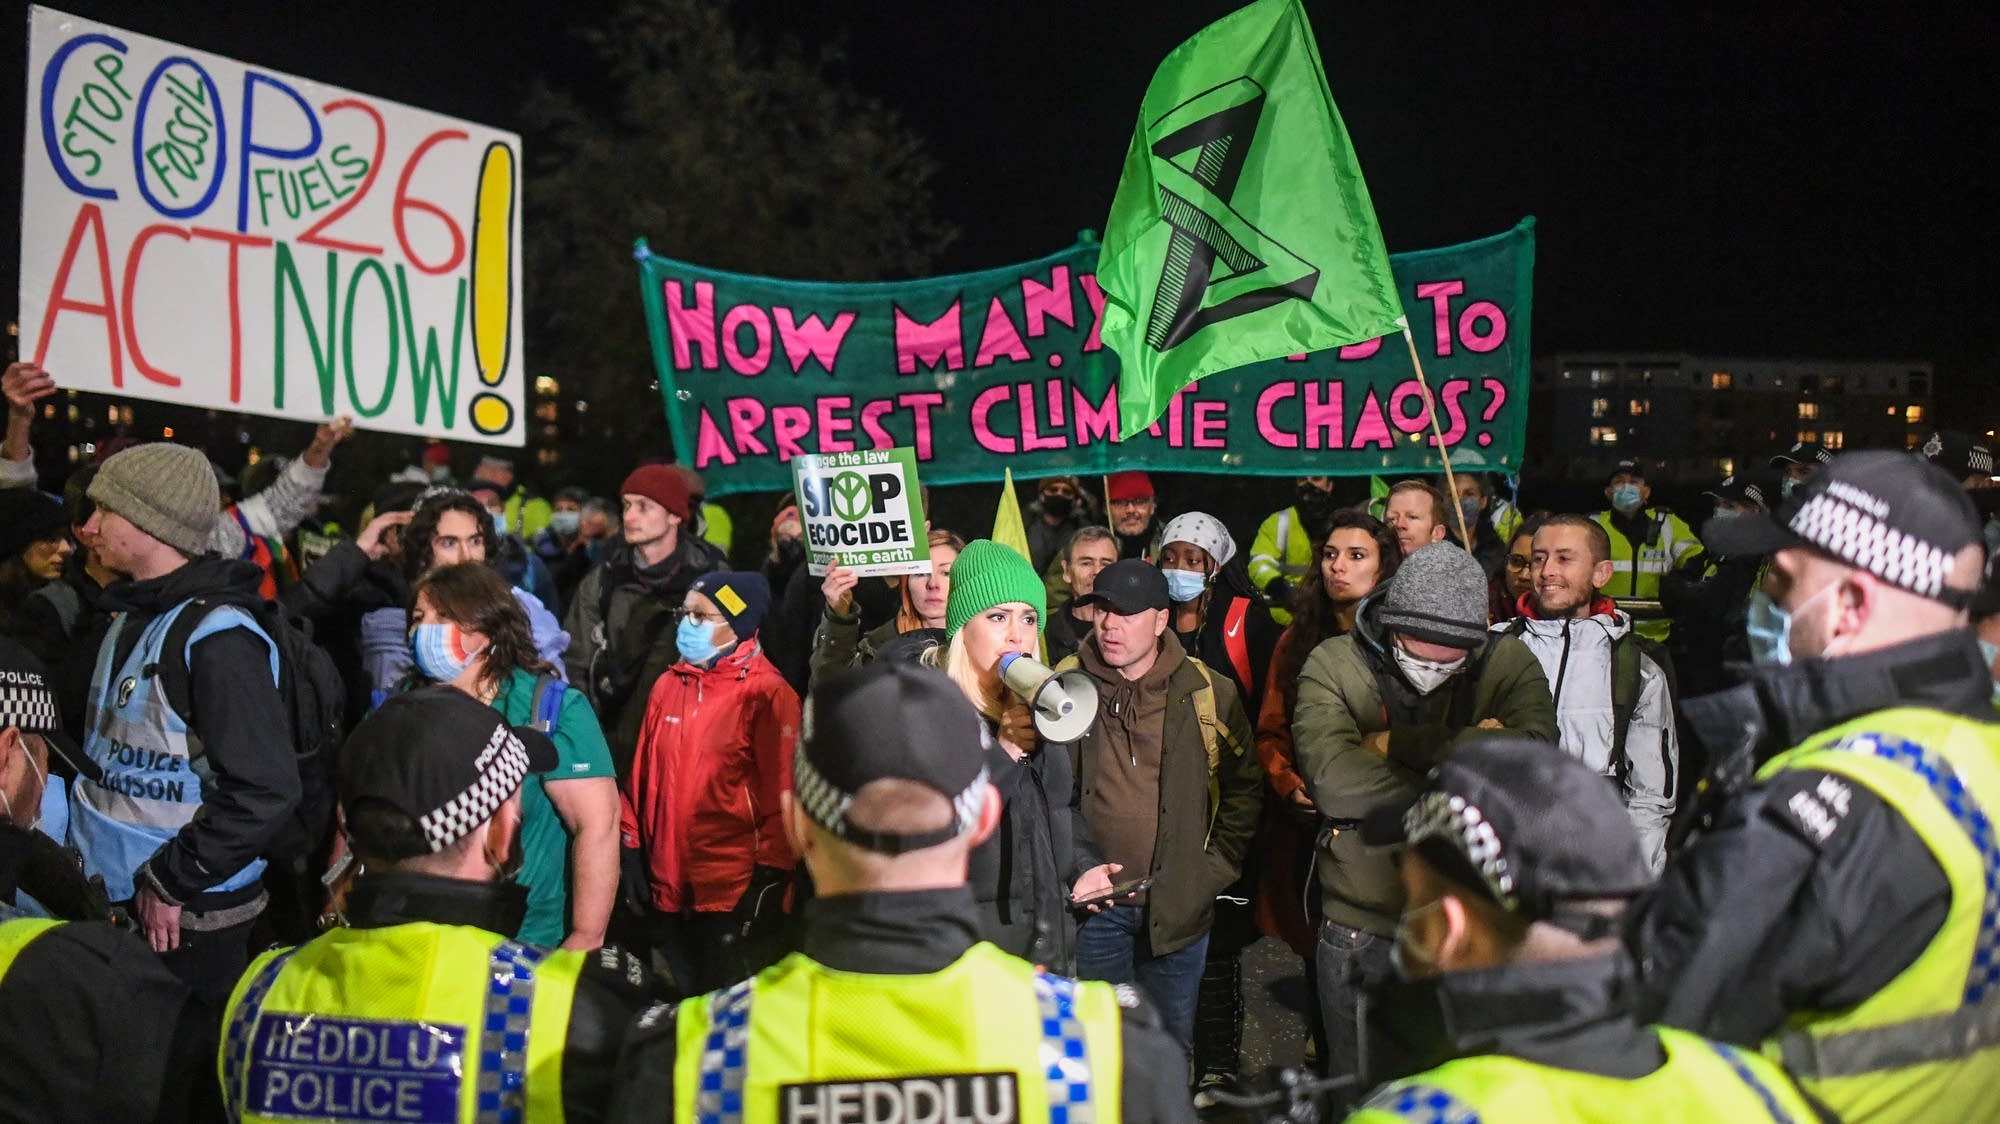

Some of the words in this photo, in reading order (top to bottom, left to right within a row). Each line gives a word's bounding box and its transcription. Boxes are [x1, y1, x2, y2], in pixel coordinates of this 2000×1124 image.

[62, 54, 131, 176] STOP
[255, 144, 369, 226] FUELS
[33, 203, 273, 404] ACT
[694, 391, 944, 470] ARREST
[1255, 379, 1507, 450] CHAOS?
[838, 451, 860, 466] the
[863, 449, 890, 464] law
[807, 519, 909, 547] ECOCIDE
[842, 552, 868, 566] the
[872, 547, 913, 561] earth
[0, 671, 45, 686] POLICE
[107, 737, 184, 772] POLICE
[474, 723, 508, 773] POLICE
[264, 1018, 443, 1070] HEDDLU
[263, 1069, 424, 1120] POLICE
[788, 1075, 1015, 1124] HEDDLU
